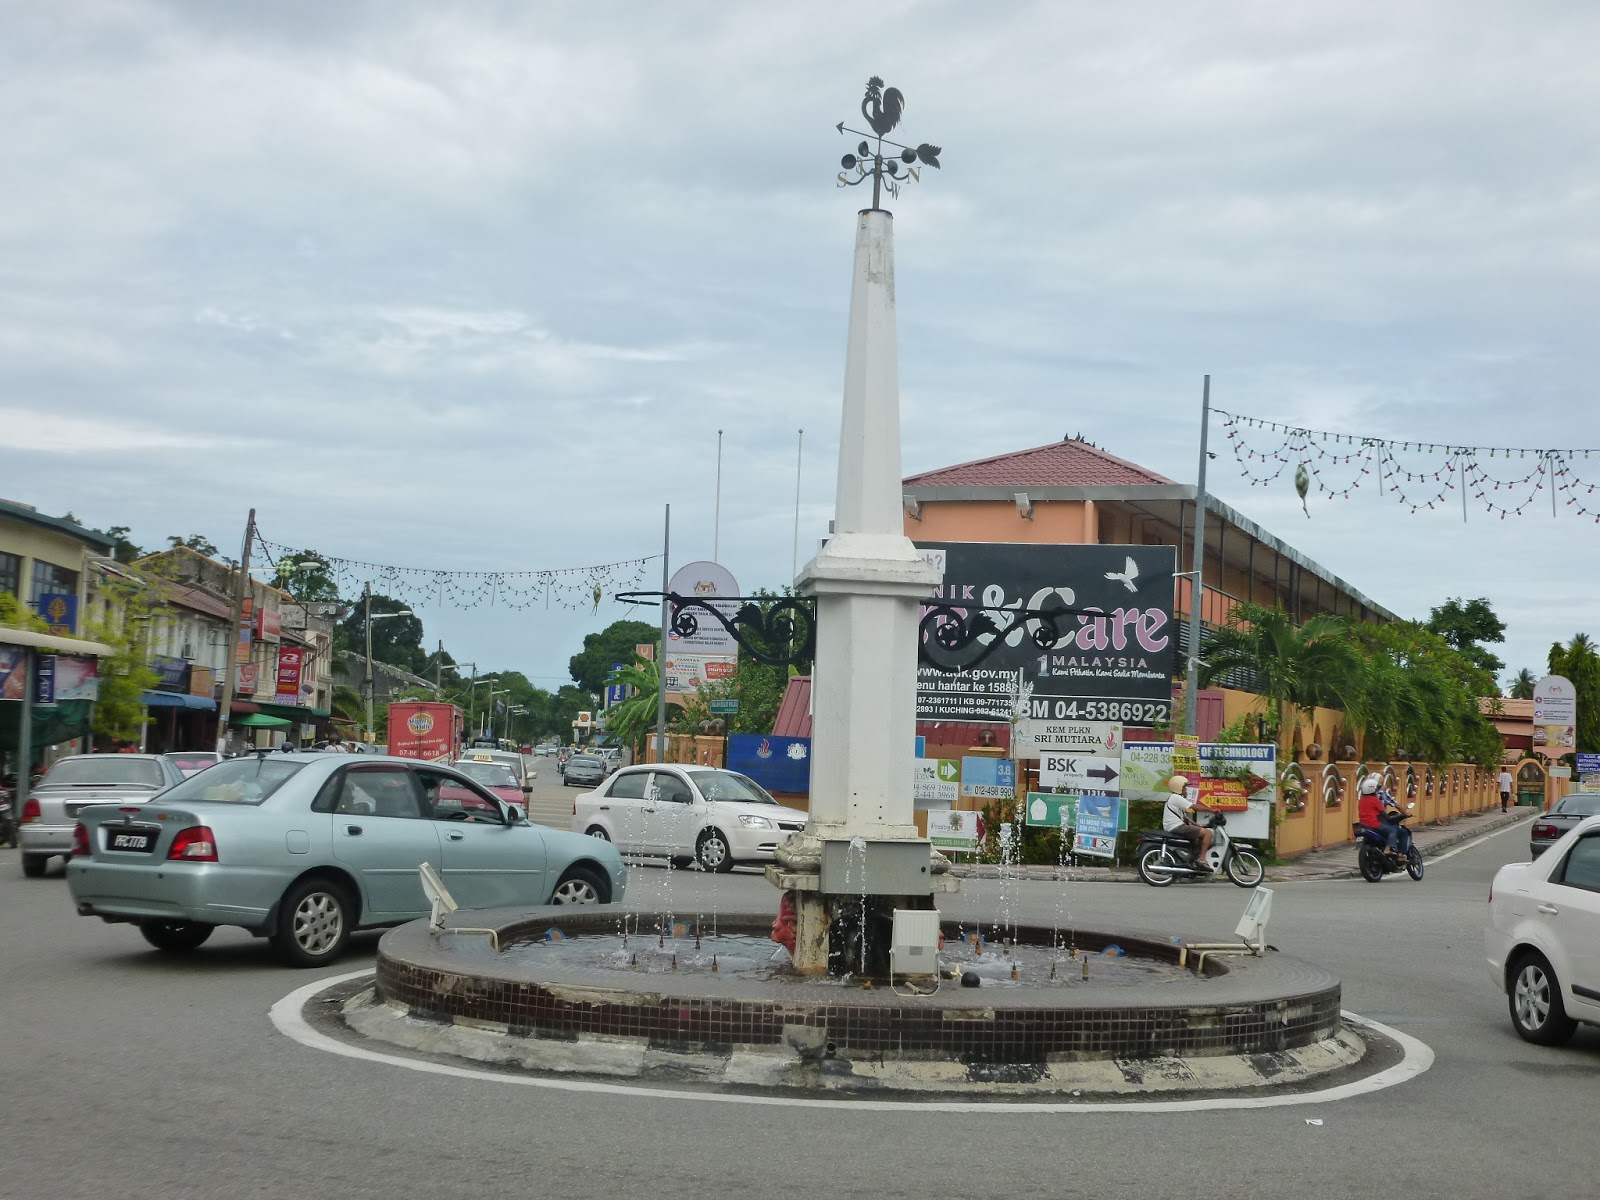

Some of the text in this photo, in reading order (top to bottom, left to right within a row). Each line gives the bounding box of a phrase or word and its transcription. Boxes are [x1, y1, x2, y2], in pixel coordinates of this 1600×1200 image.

[836, 171, 848, 188] S
[905, 166, 921, 184] N
[1026, 586, 1169, 653] Care
[1052, 655, 1148, 669] MALAYSIA
[938, 680, 971, 692] hantar
[973, 681, 985, 692] ke
[939, 706, 975, 714] KUCHING
[1054, 700, 1168, 723] 04-5386922
[1046, 726, 1091, 734] KEM PLKN
[1034, 735, 1102, 744] SRI MUTIARA
[1201, 746, 1212, 757] OF
[998, 765, 1011, 776] 3.8
[1047, 757, 1077, 772] BSK
